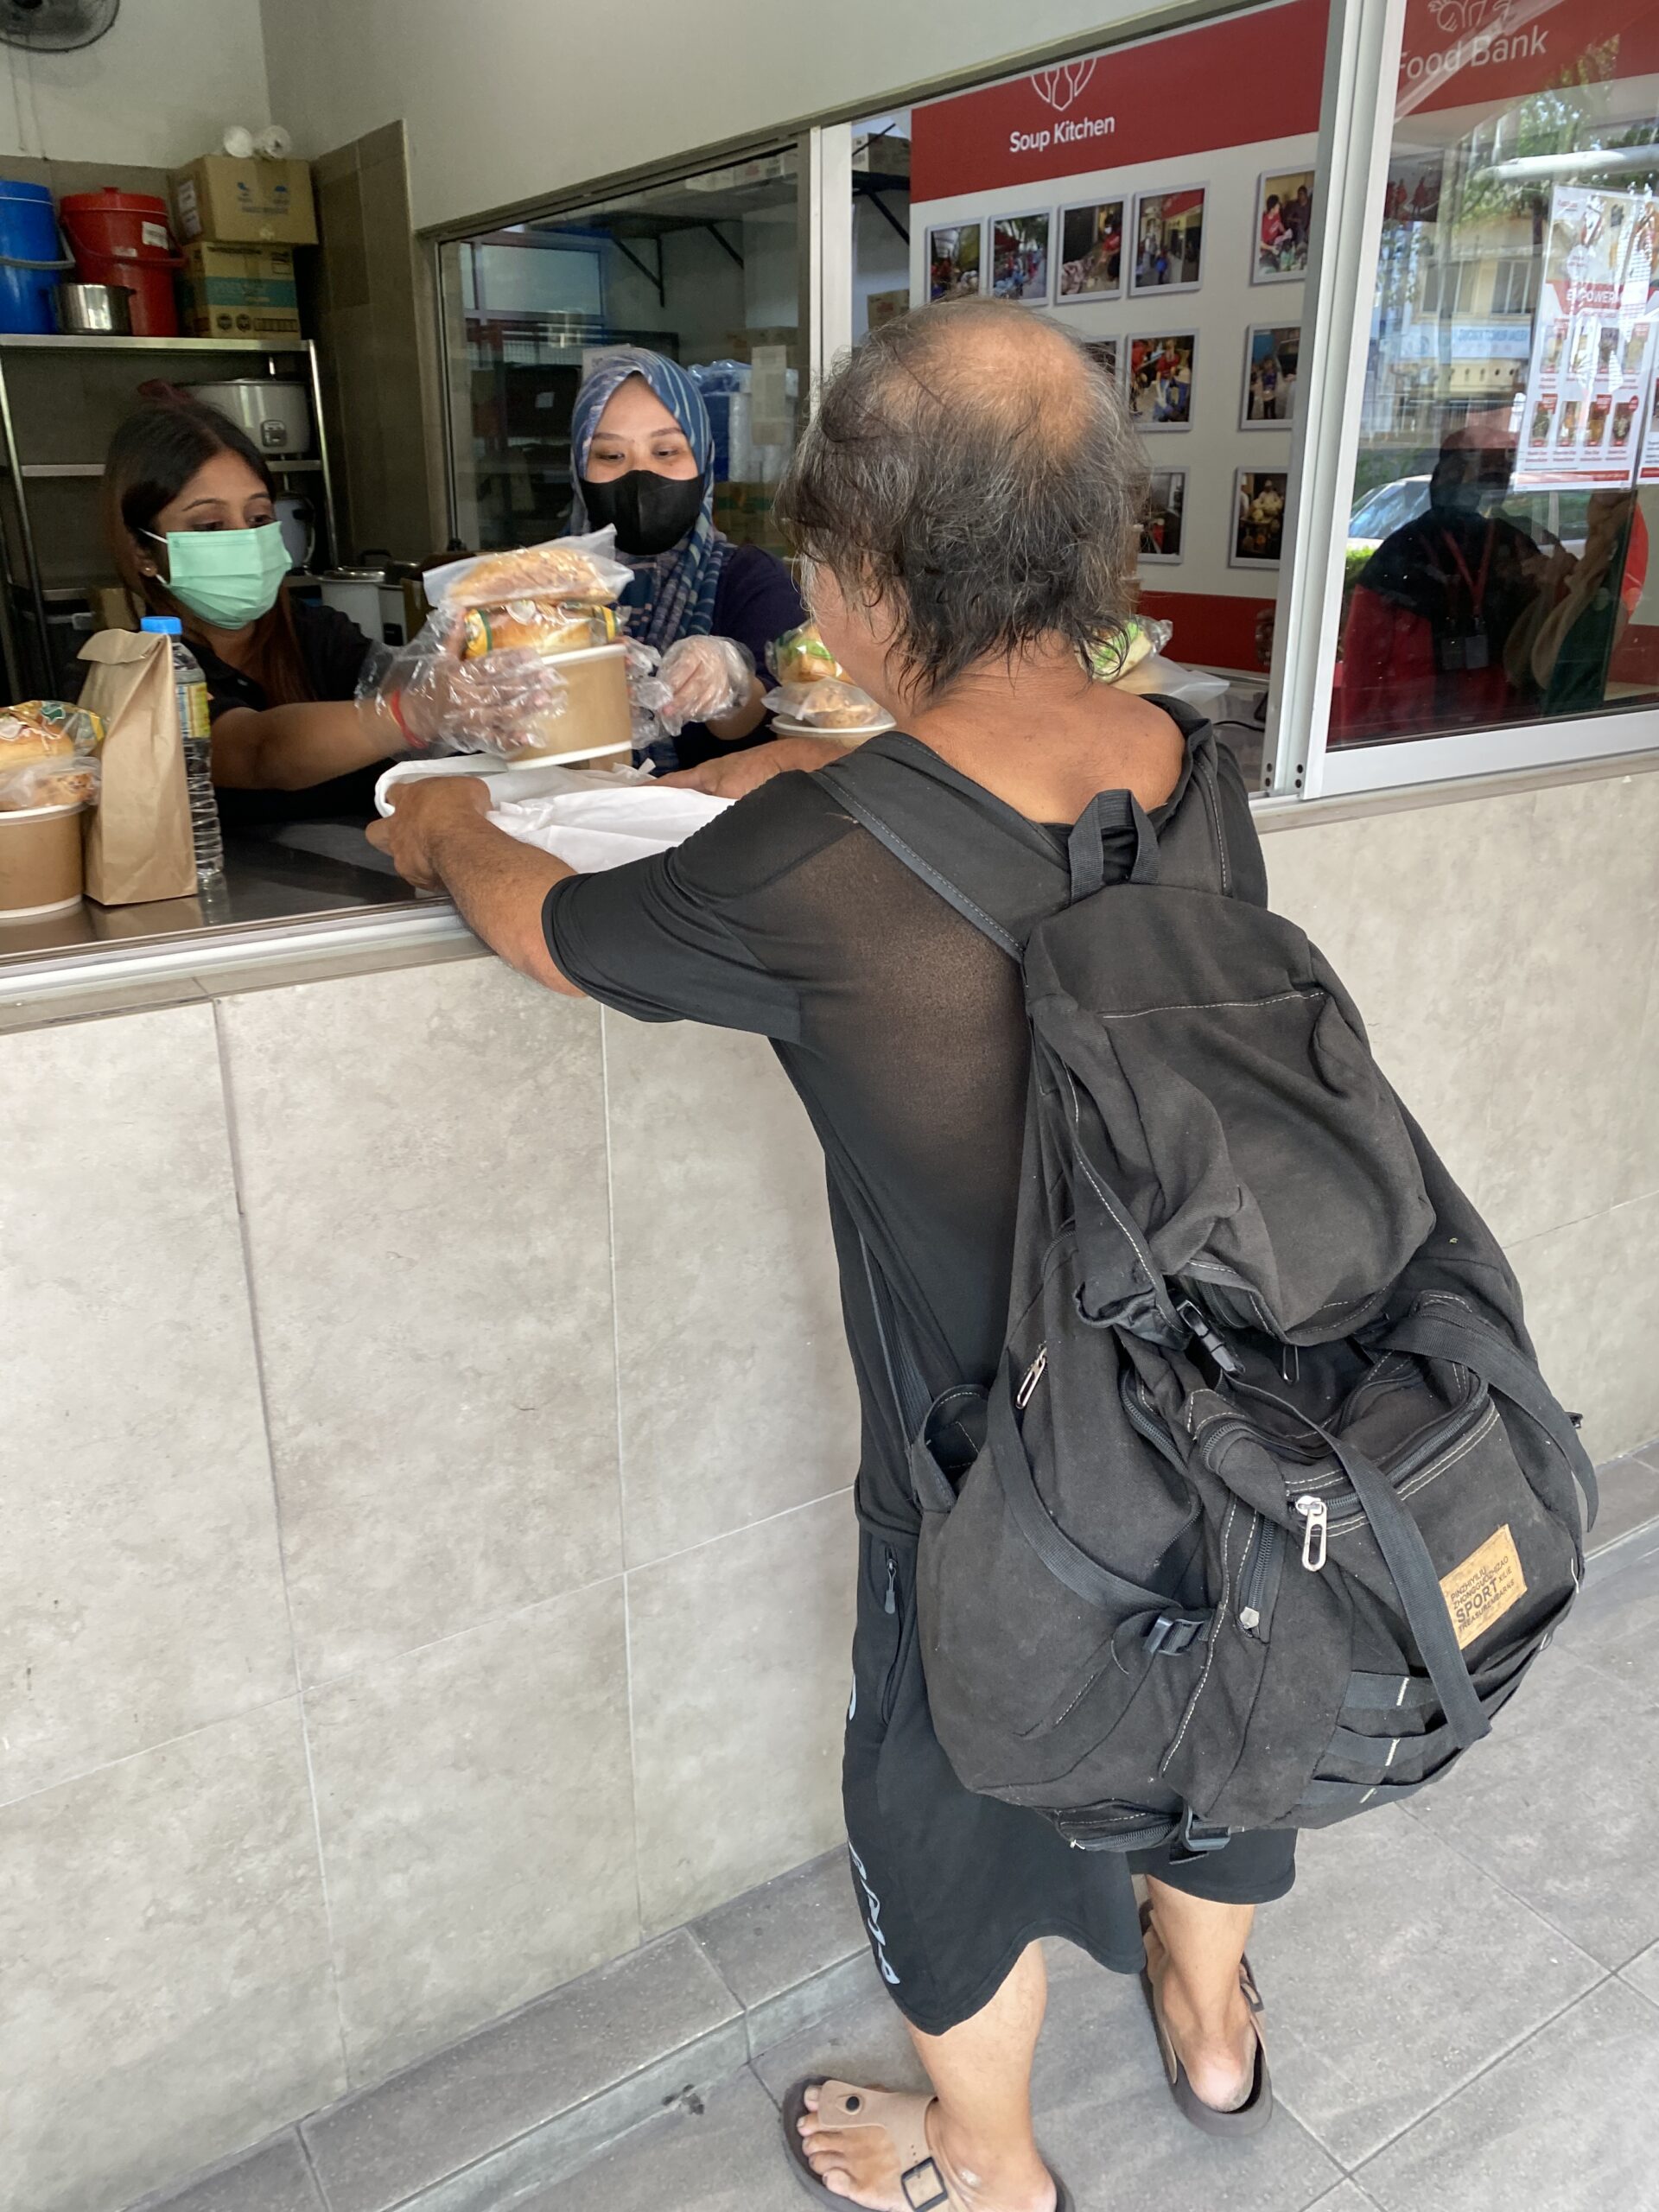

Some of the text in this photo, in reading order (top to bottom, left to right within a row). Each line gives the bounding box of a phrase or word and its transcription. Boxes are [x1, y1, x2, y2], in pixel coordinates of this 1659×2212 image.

[1471, 24, 1548, 67] Bank
[1009, 117, 1115, 152] Soup Kitchen
[1456, 1578, 1497, 1624] SPORT
